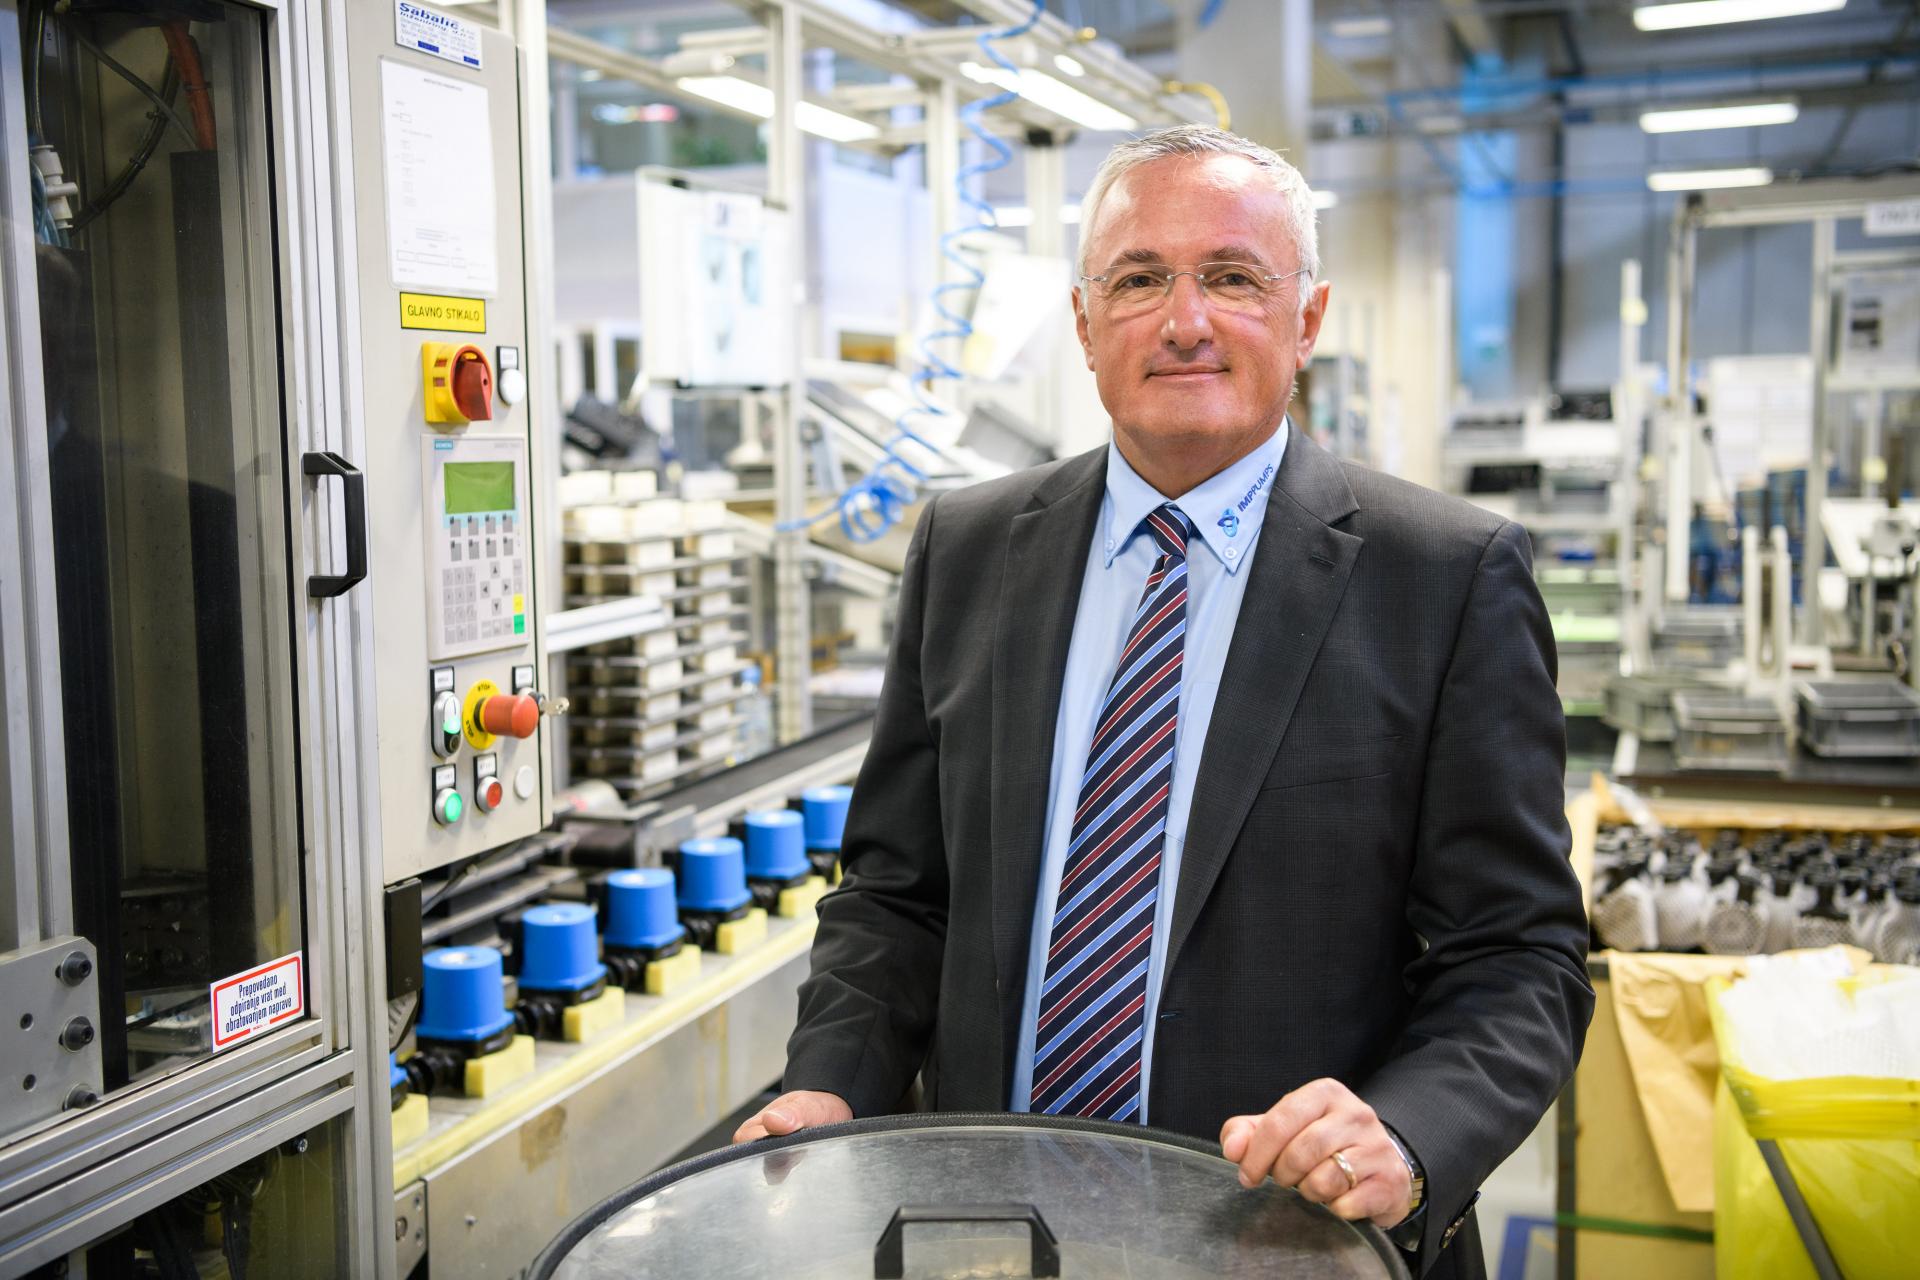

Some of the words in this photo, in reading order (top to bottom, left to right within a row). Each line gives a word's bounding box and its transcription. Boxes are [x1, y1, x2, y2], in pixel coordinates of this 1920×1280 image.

[407, 304, 442, 318] GLAVNO
[446, 308, 480, 321] STIKALO
[230, 994, 260, 1016] odpiranje
[261, 989, 273, 1004] vrat
[274, 981, 287, 998] med
[238, 974, 278, 998] Prepovedano
[226, 1007, 267, 1032] obratovanjem
[268, 997, 292, 1015] naprave
